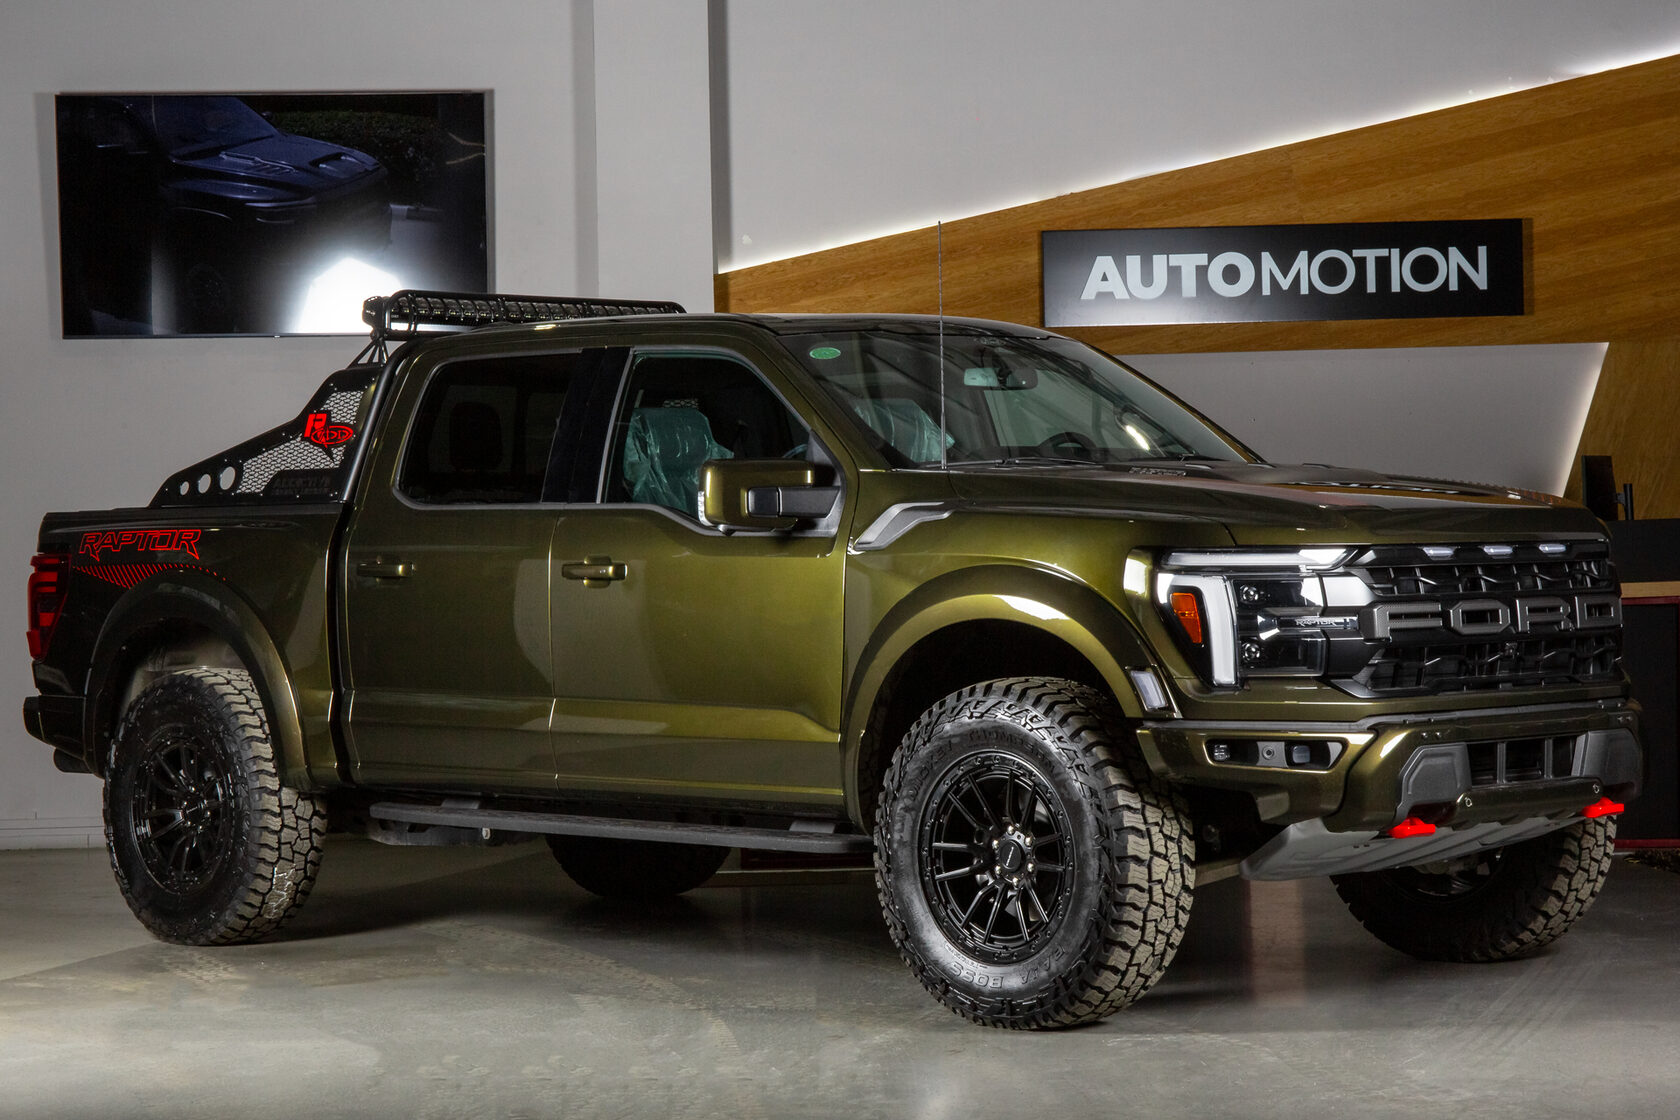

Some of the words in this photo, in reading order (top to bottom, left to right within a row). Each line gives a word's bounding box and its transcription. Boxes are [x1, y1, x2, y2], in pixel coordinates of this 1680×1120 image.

[1080, 245, 1489, 300] AUTOMOTION
[79, 528, 201, 562] RAPTOR
[1362, 595, 1623, 641] FORD
[948, 960, 1005, 989] BOSS
